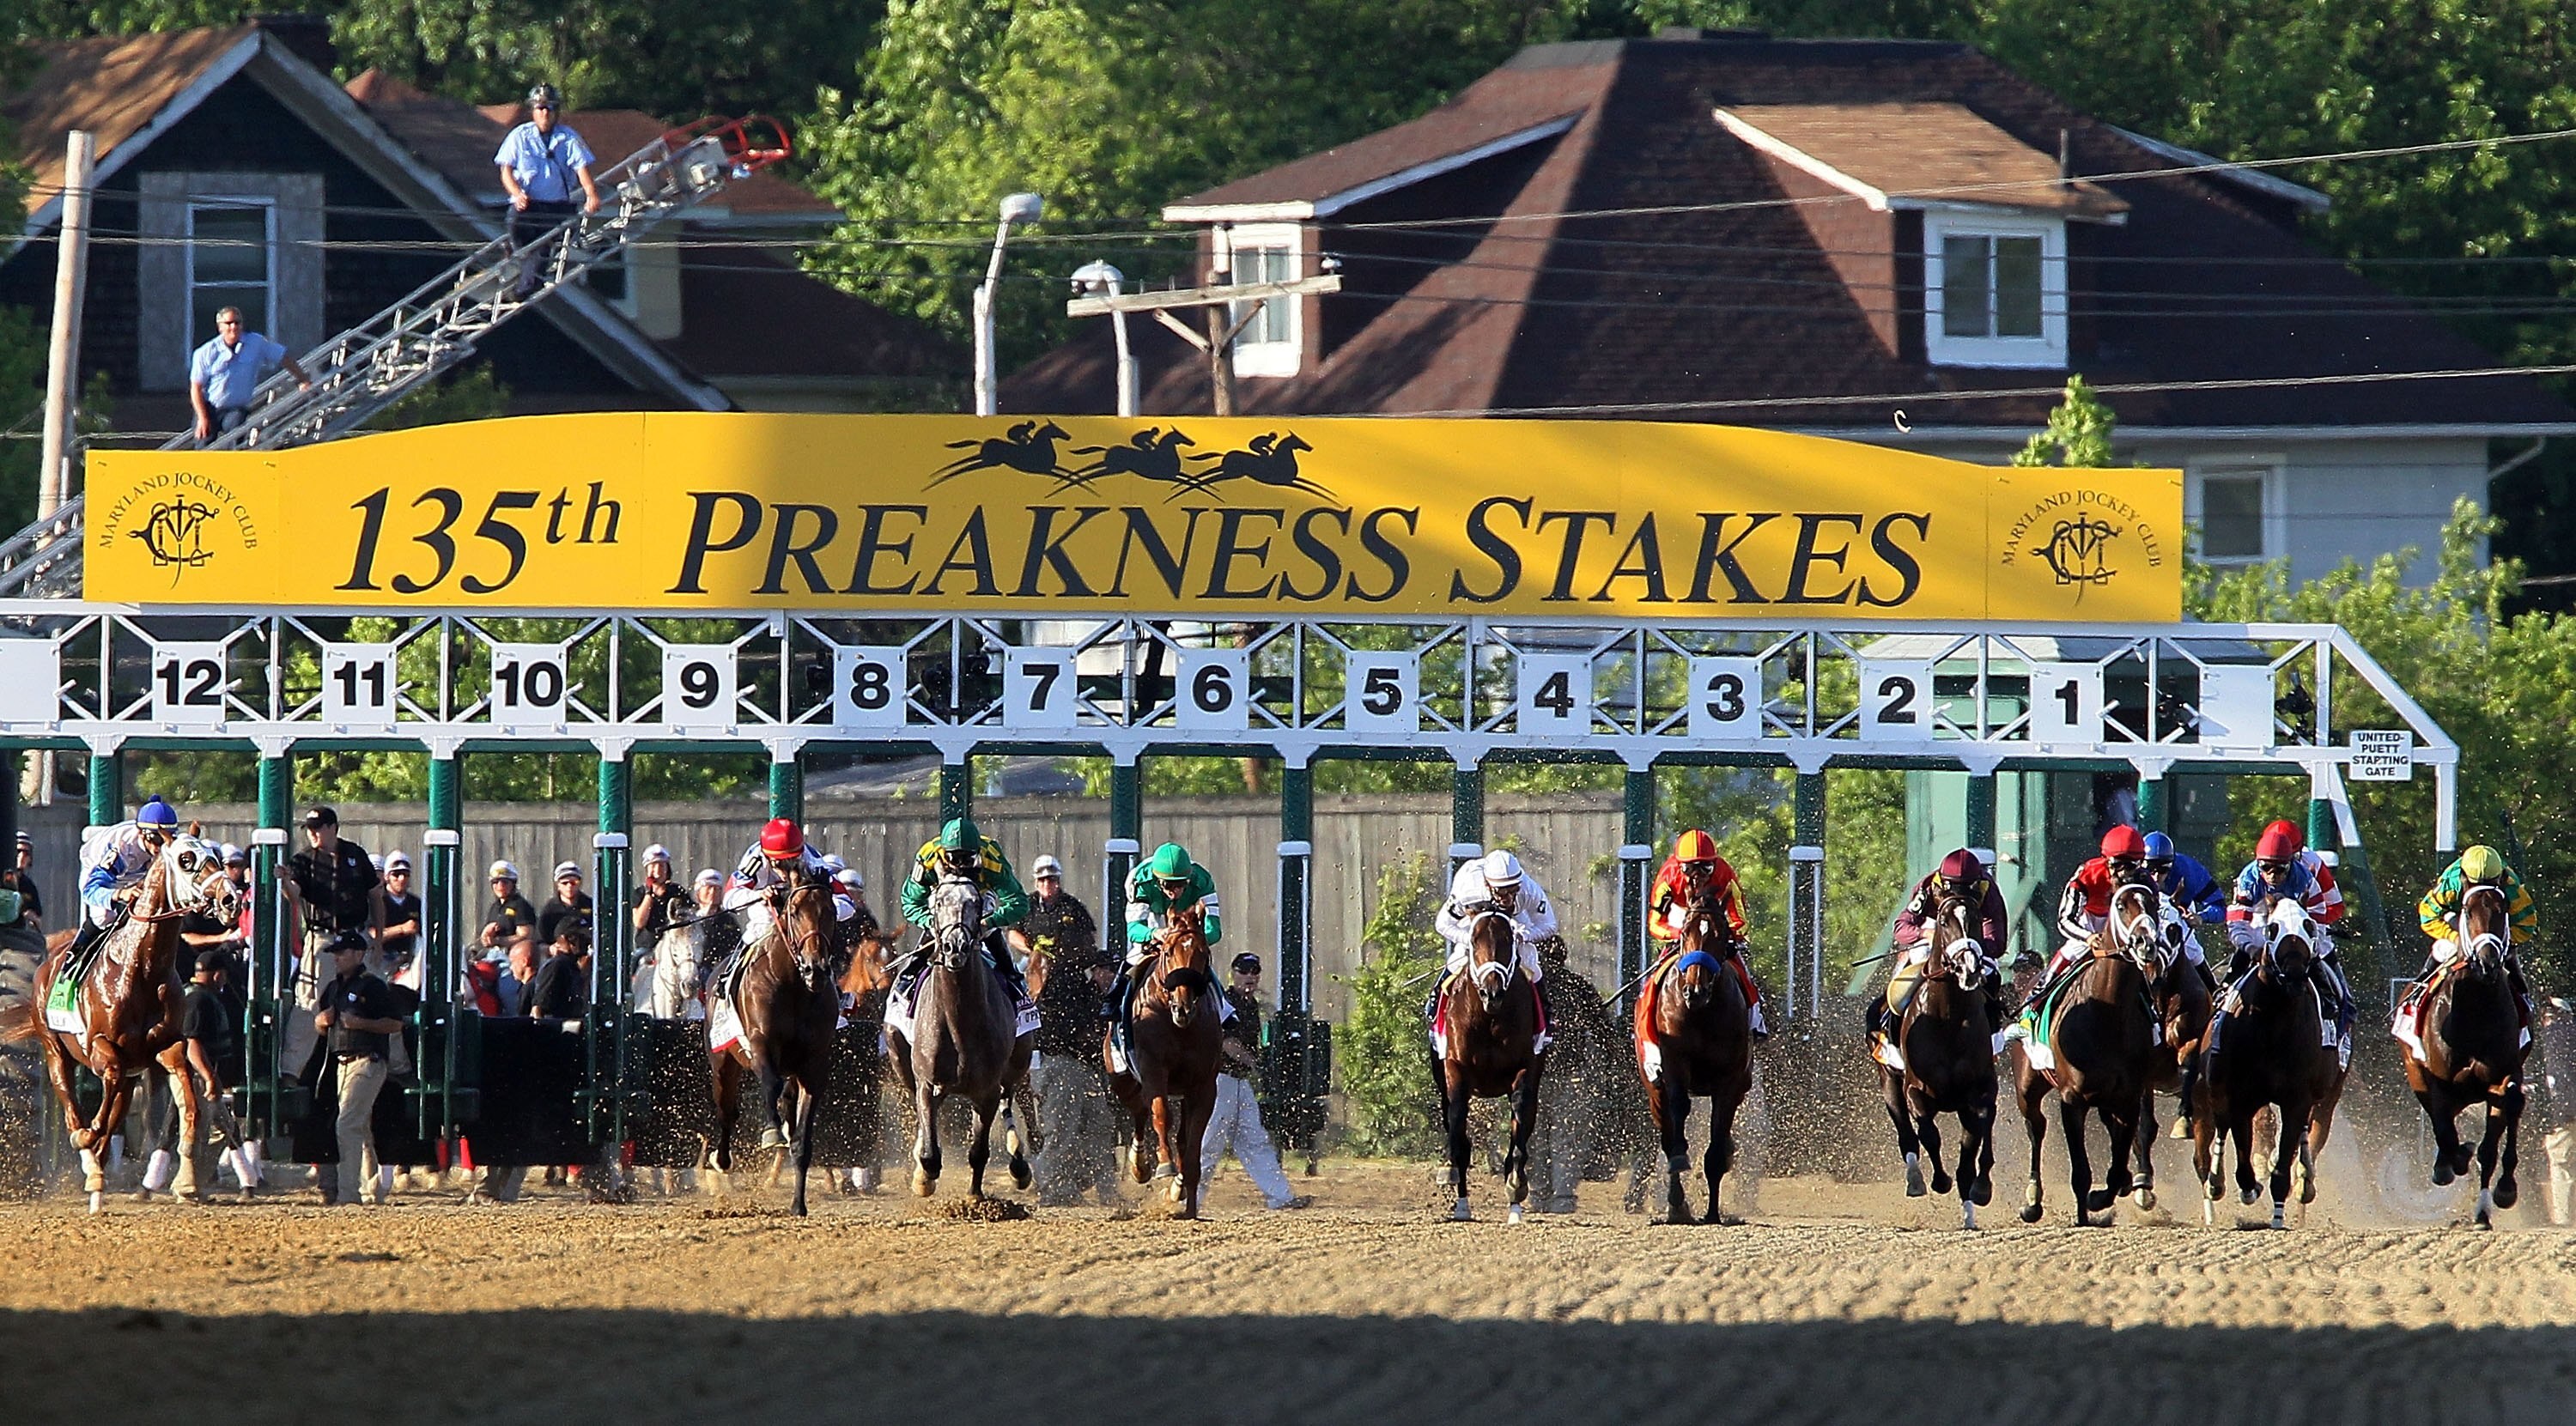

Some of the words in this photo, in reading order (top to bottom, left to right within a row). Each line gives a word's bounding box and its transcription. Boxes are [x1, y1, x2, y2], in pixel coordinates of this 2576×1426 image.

[100, 474, 169, 549] MARYLAND
[173, 472, 237, 504] JOCKEY
[233, 505, 258, 549] CLUB
[2002, 491, 2072, 567] MARYLAND
[2076, 489, 2141, 522] JOCKEY
[2137, 524, 2162, 567] CLUB
[334, 482, 621, 593] 135th
[665, 492, 1419, 602] PREAKNESS
[1448, 496, 1930, 607] STAKES
[157, 659, 222, 706] 12
[334, 661, 384, 707] 11
[496, 661, 563, 707] 10
[681, 662, 719, 708] 9
[851, 663, 890, 709] 8
[1023, 664, 1060, 710] 7
[1193, 665, 1232, 713] 6
[1363, 669, 1401, 715] 5
[1534, 672, 1574, 719] 4
[1707, 674, 1745, 721] 3
[1878, 677, 1916, 724] 2
[2056, 680, 2078, 725] 1
[2353, 755, 2409, 765] STARTING
[2357, 732, 2405, 742] UNITED-
[2361, 743, 2401, 753] PUETT
[2366, 767, 2396, 776] GATE
[1662, 895, 1673, 913] 7
[1908, 893, 1925, 912] 6
